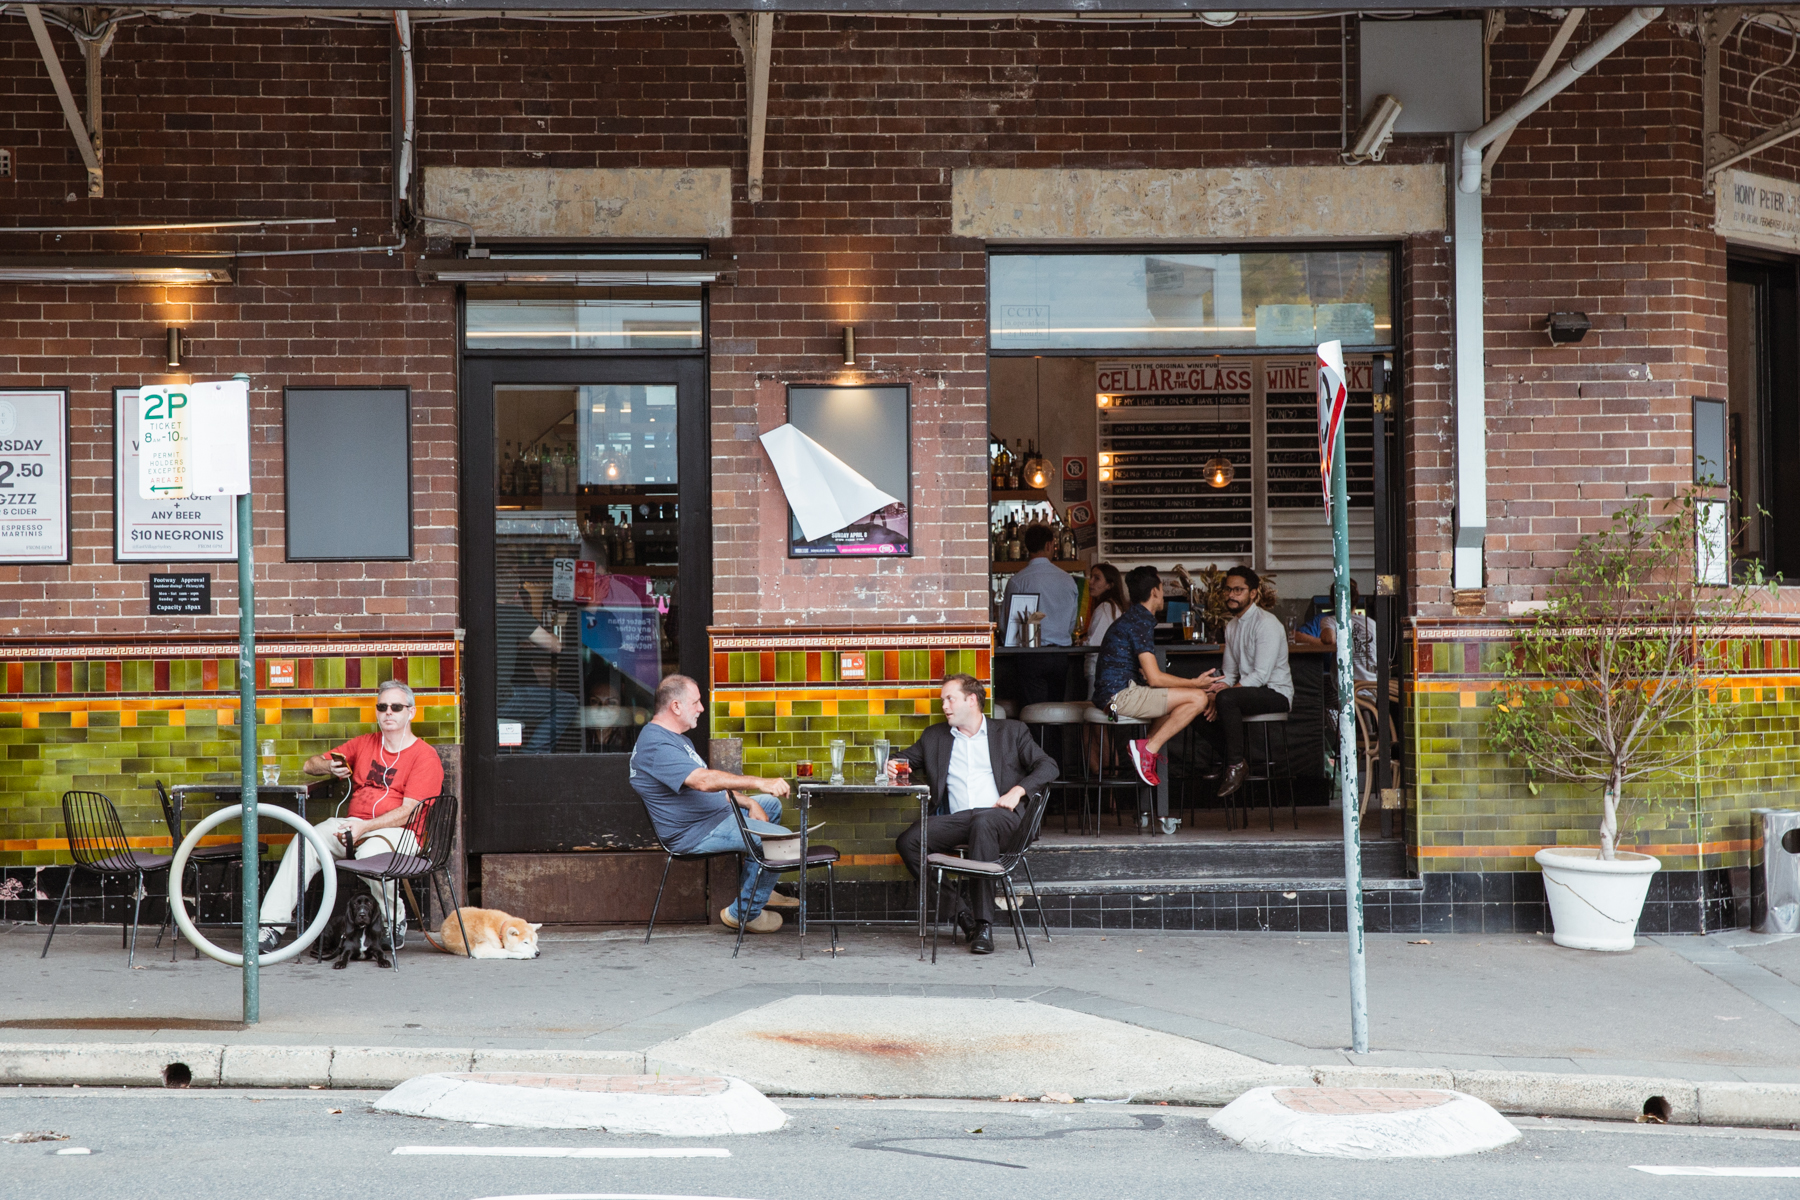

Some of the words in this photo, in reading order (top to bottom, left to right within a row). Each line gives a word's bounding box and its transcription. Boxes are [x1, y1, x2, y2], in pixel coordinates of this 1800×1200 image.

[1760, 188, 1784, 212] PETER
[1008, 308, 1042, 317] CCTV
[1098, 370, 1174, 391] CELLAR
[1174, 380, 1188, 389] THE
[1188, 370, 1251, 391] GLASS
[1267, 367, 1309, 389] WINE
[144, 393, 187, 420] 2P
[0, 440, 43, 451] SDAY
[170, 492, 212, 500] GER
[131, 529, 152, 541] $10
[155, 530, 223, 540] NEGRONIS
[842, 659, 851, 667] NO
[271, 666, 281, 674] NO
